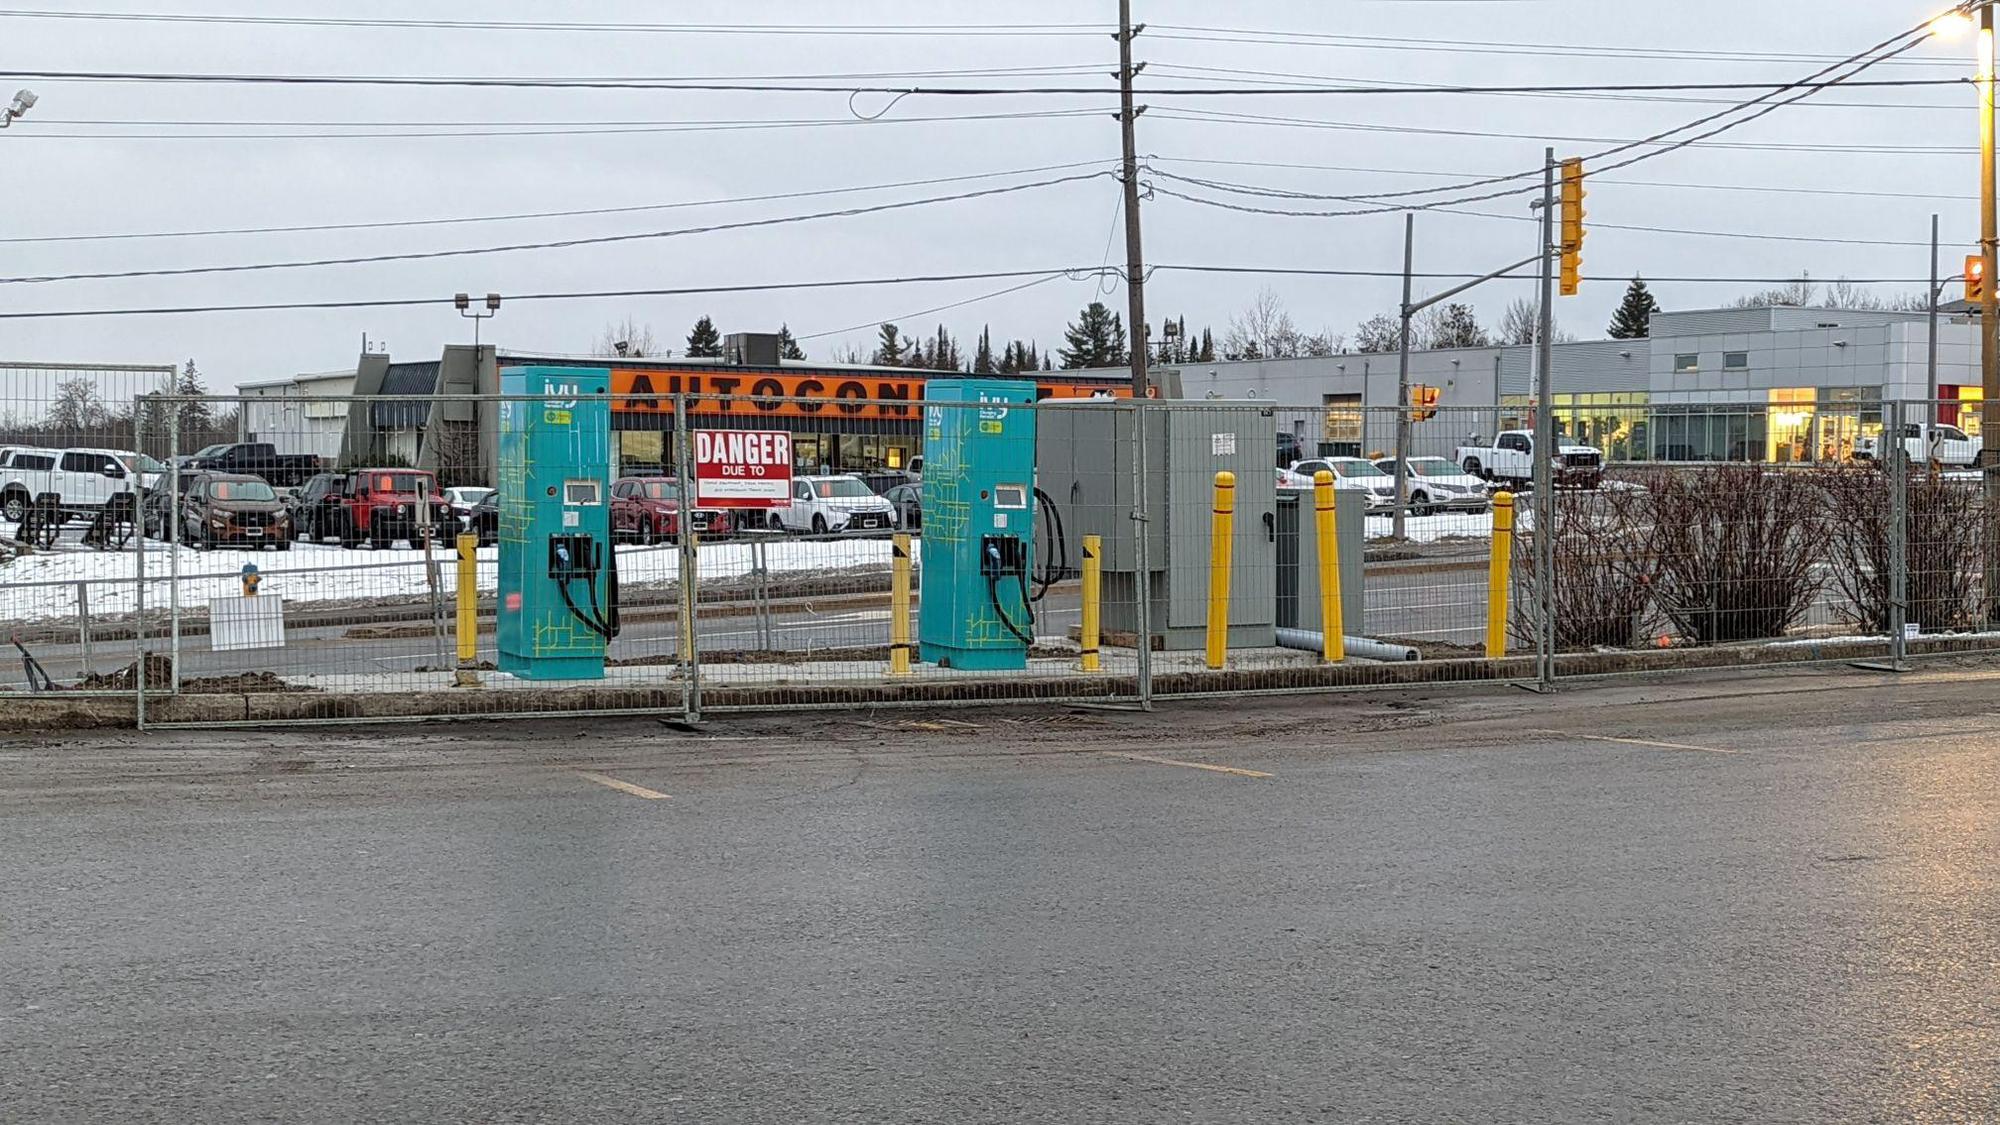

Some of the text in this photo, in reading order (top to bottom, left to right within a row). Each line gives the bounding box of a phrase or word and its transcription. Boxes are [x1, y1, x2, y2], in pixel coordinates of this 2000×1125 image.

[544, 378, 578, 409] ivy
[624, 374, 924, 416] AUTOCON
[696, 433, 789, 465] DANGER
[722, 465, 765, 476] DUE TO
